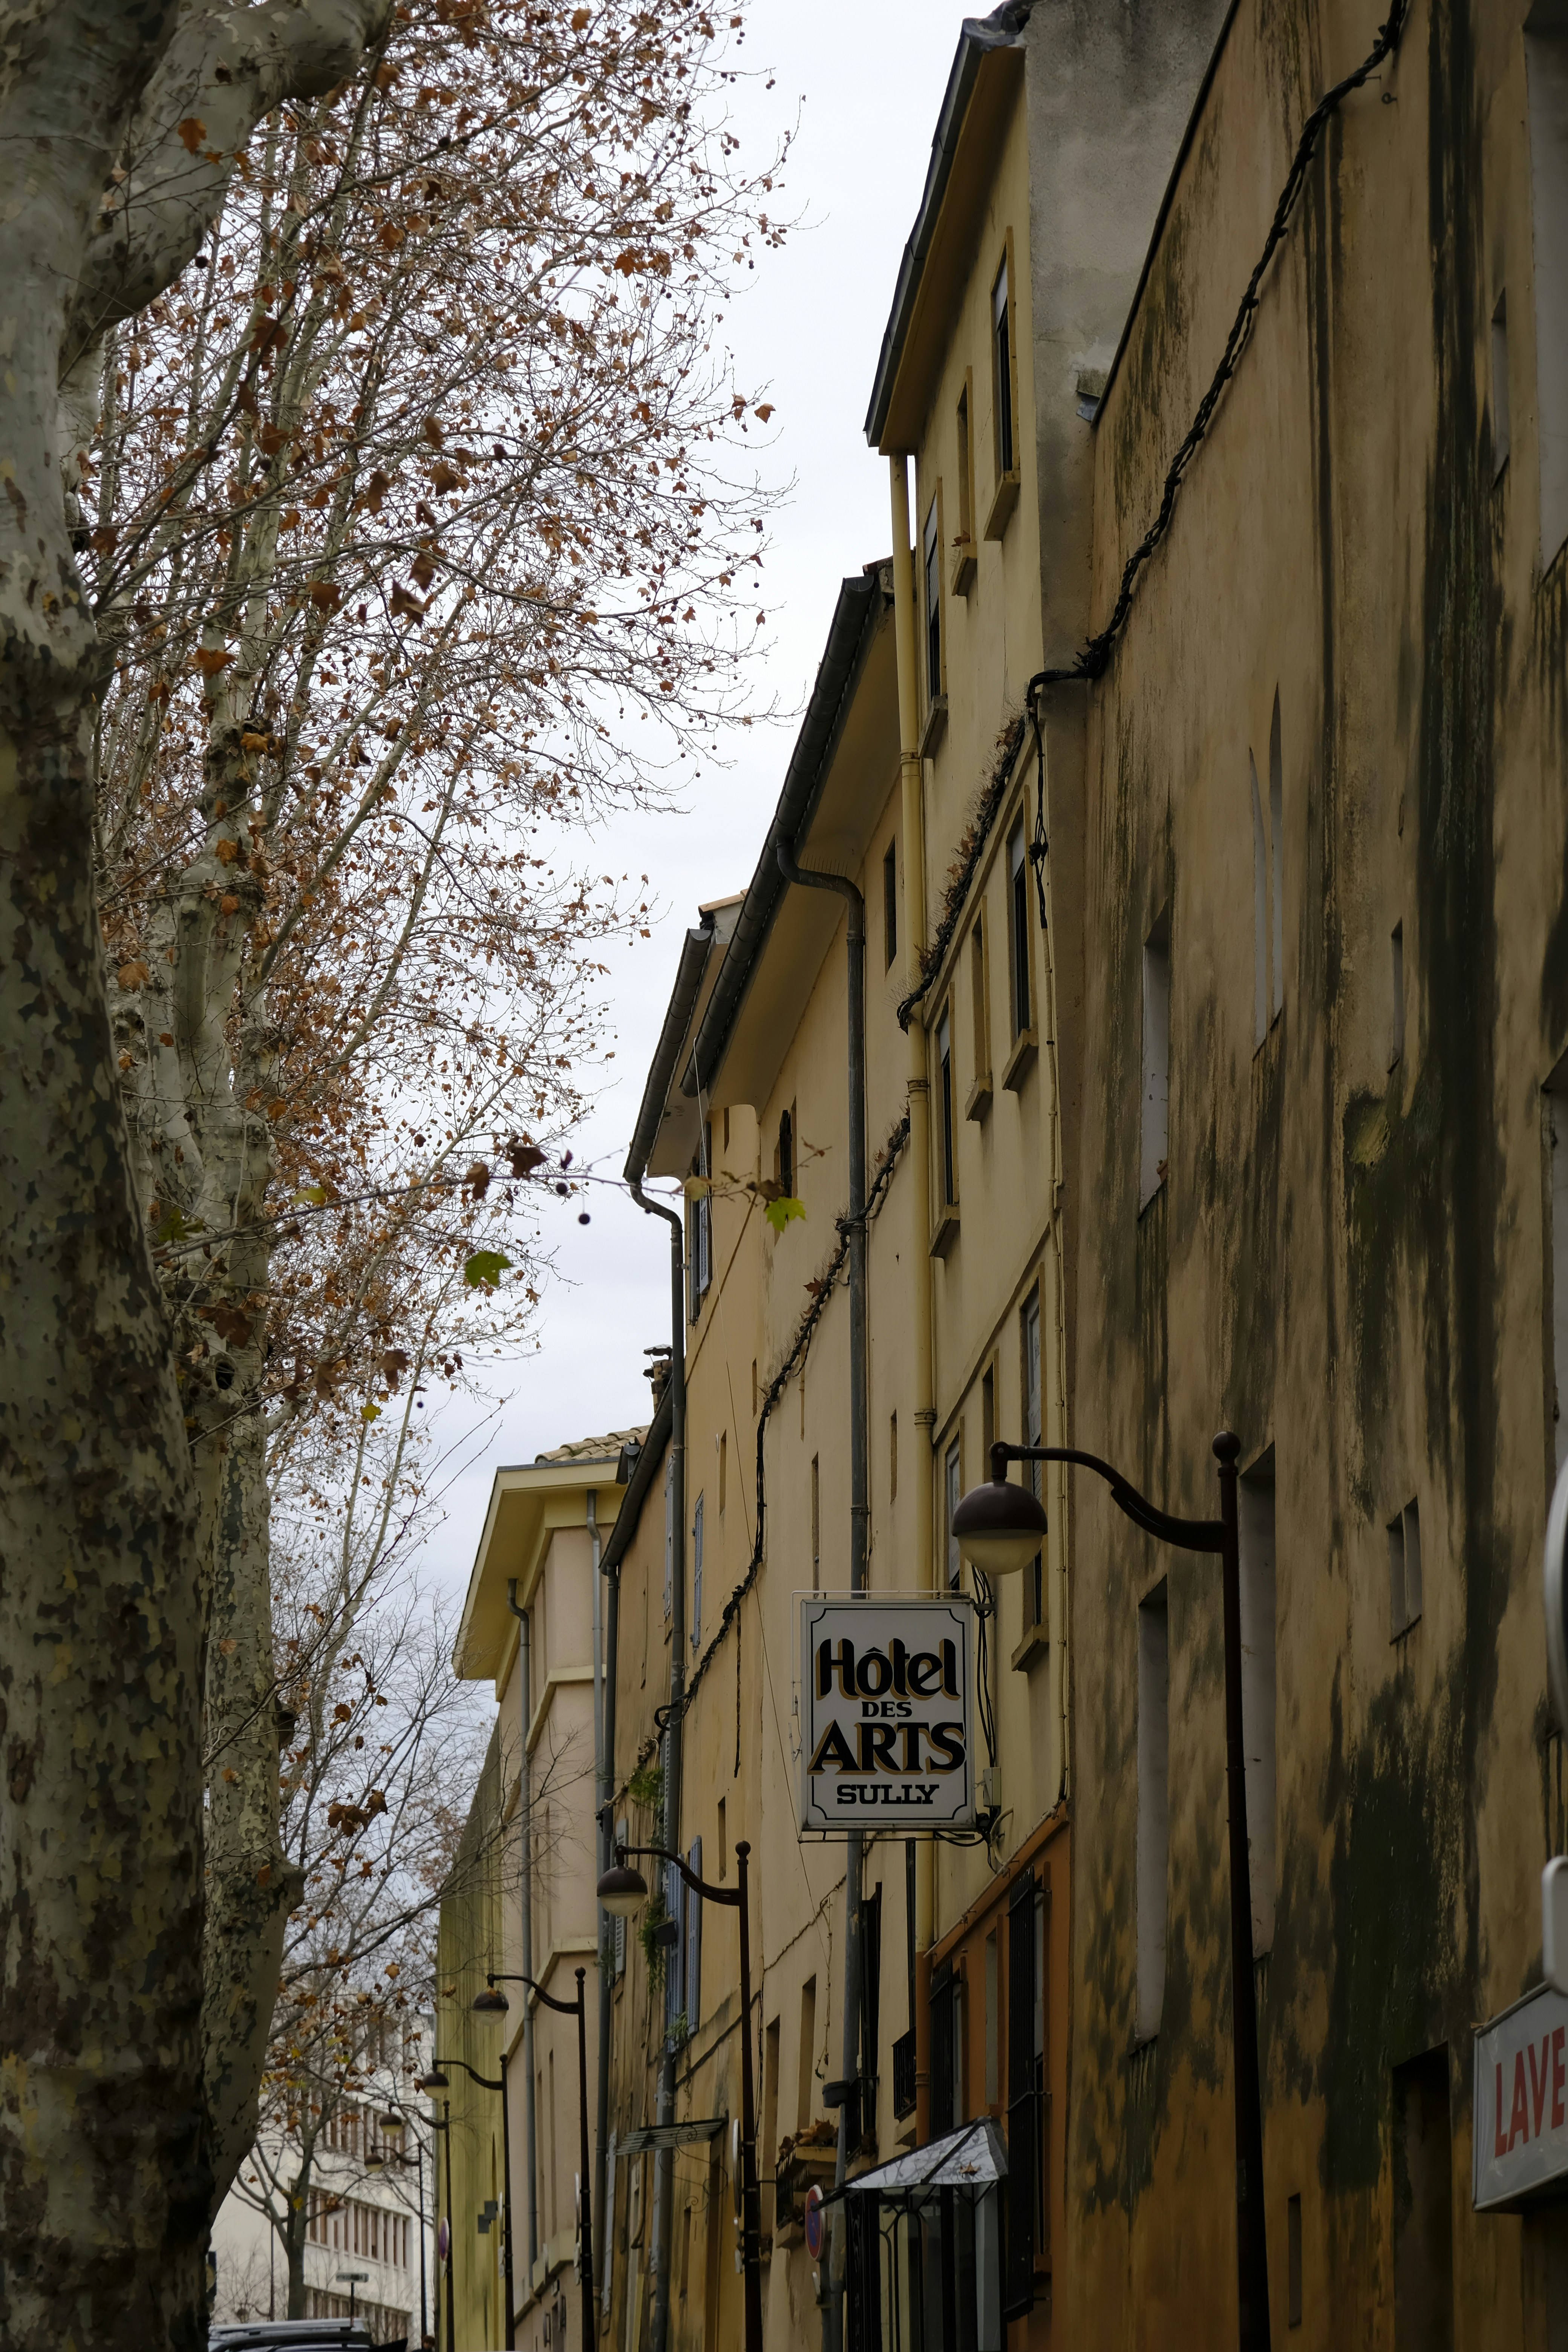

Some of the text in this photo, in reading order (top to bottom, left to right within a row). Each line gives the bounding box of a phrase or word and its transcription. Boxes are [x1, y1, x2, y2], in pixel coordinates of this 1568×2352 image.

[815, 1638, 961, 1701] Hôtel
[862, 1701, 913, 1717] DES
[807, 1719, 966, 1775] ARTS
[837, 1784, 940, 1804] SULLY
[1495, 2026, 1565, 2158] LAVE
